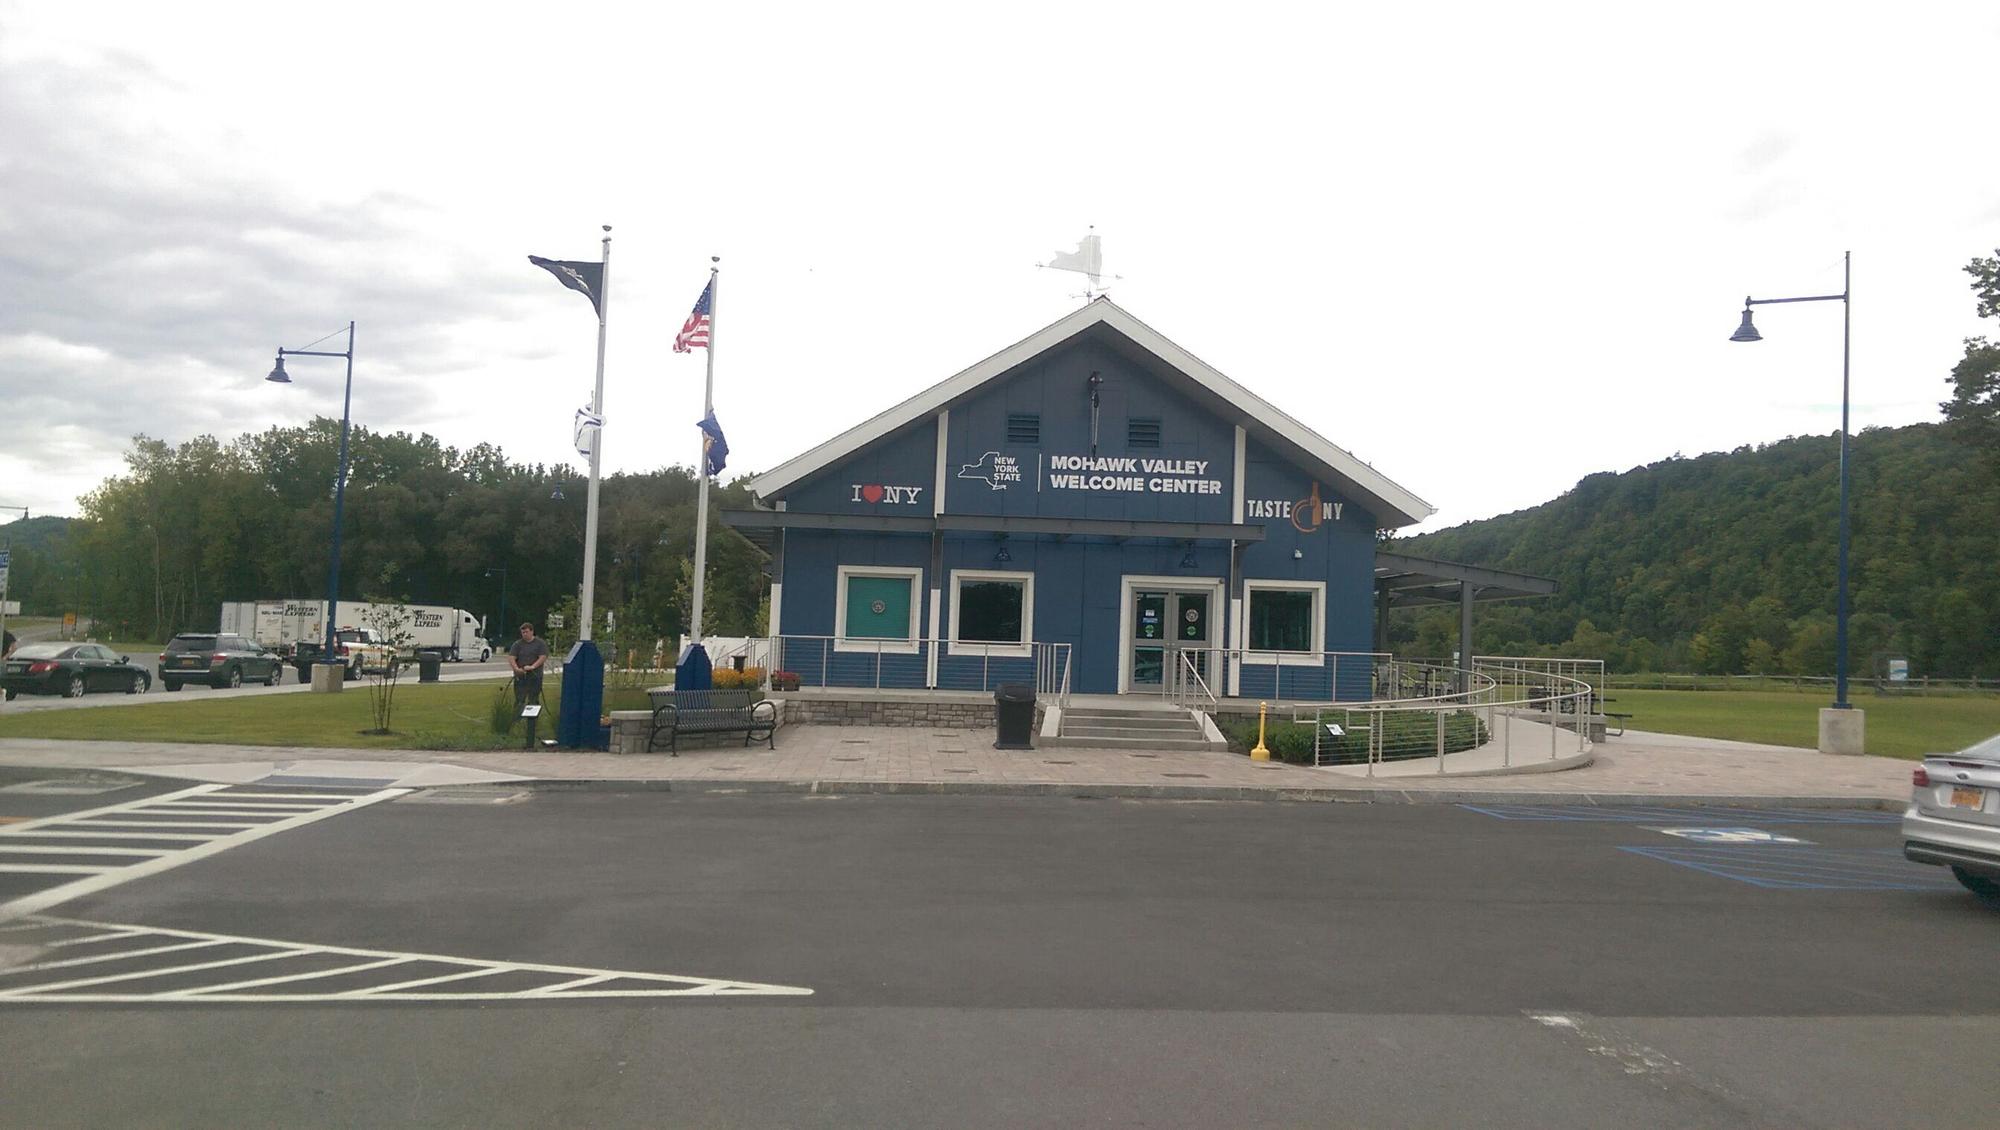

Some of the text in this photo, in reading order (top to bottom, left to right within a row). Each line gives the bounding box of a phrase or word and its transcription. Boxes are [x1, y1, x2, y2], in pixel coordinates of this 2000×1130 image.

[994, 457, 1016, 465] NEW
[994, 465, 1018, 473] YORK
[1051, 455, 1209, 475] MOHAWK VALLEY
[993, 473, 1020, 482] STATE
[1050, 474, 1222, 495] WELCOME CENTER
[851, 484, 922, 504] I NY
[1247, 499, 1343, 520] TASTE NY
